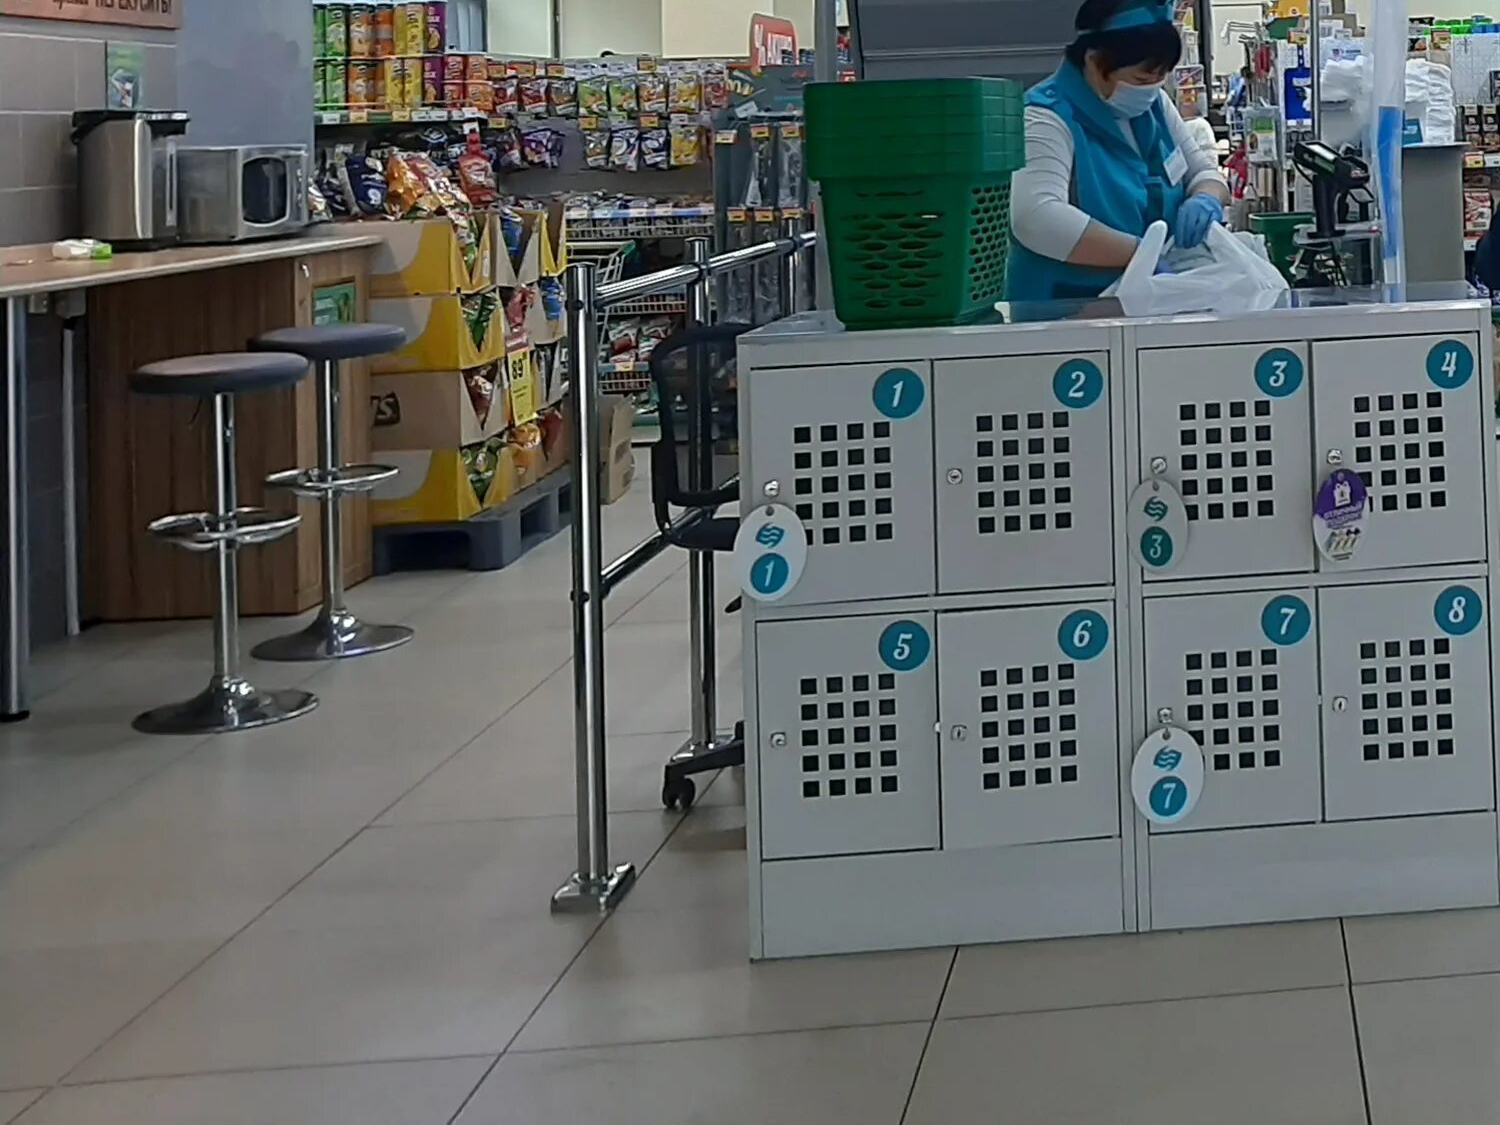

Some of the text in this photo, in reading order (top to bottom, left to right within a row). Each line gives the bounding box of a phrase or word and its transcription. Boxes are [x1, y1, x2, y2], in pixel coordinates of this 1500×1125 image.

[1268, 359, 1288, 387] 3
[1440, 350, 1458, 378] 4
[891, 380, 904, 408] 1
[1067, 371, 1087, 398] 2
[1150, 534, 1163, 559] 3
[764, 560, 775, 587] 1
[1280, 606, 1297, 636] 7
[1448, 595, 1466, 624] 8
[893, 632, 913, 660] 5
[1073, 619, 1093, 647] 6
[1162, 783, 1177, 809] 7
